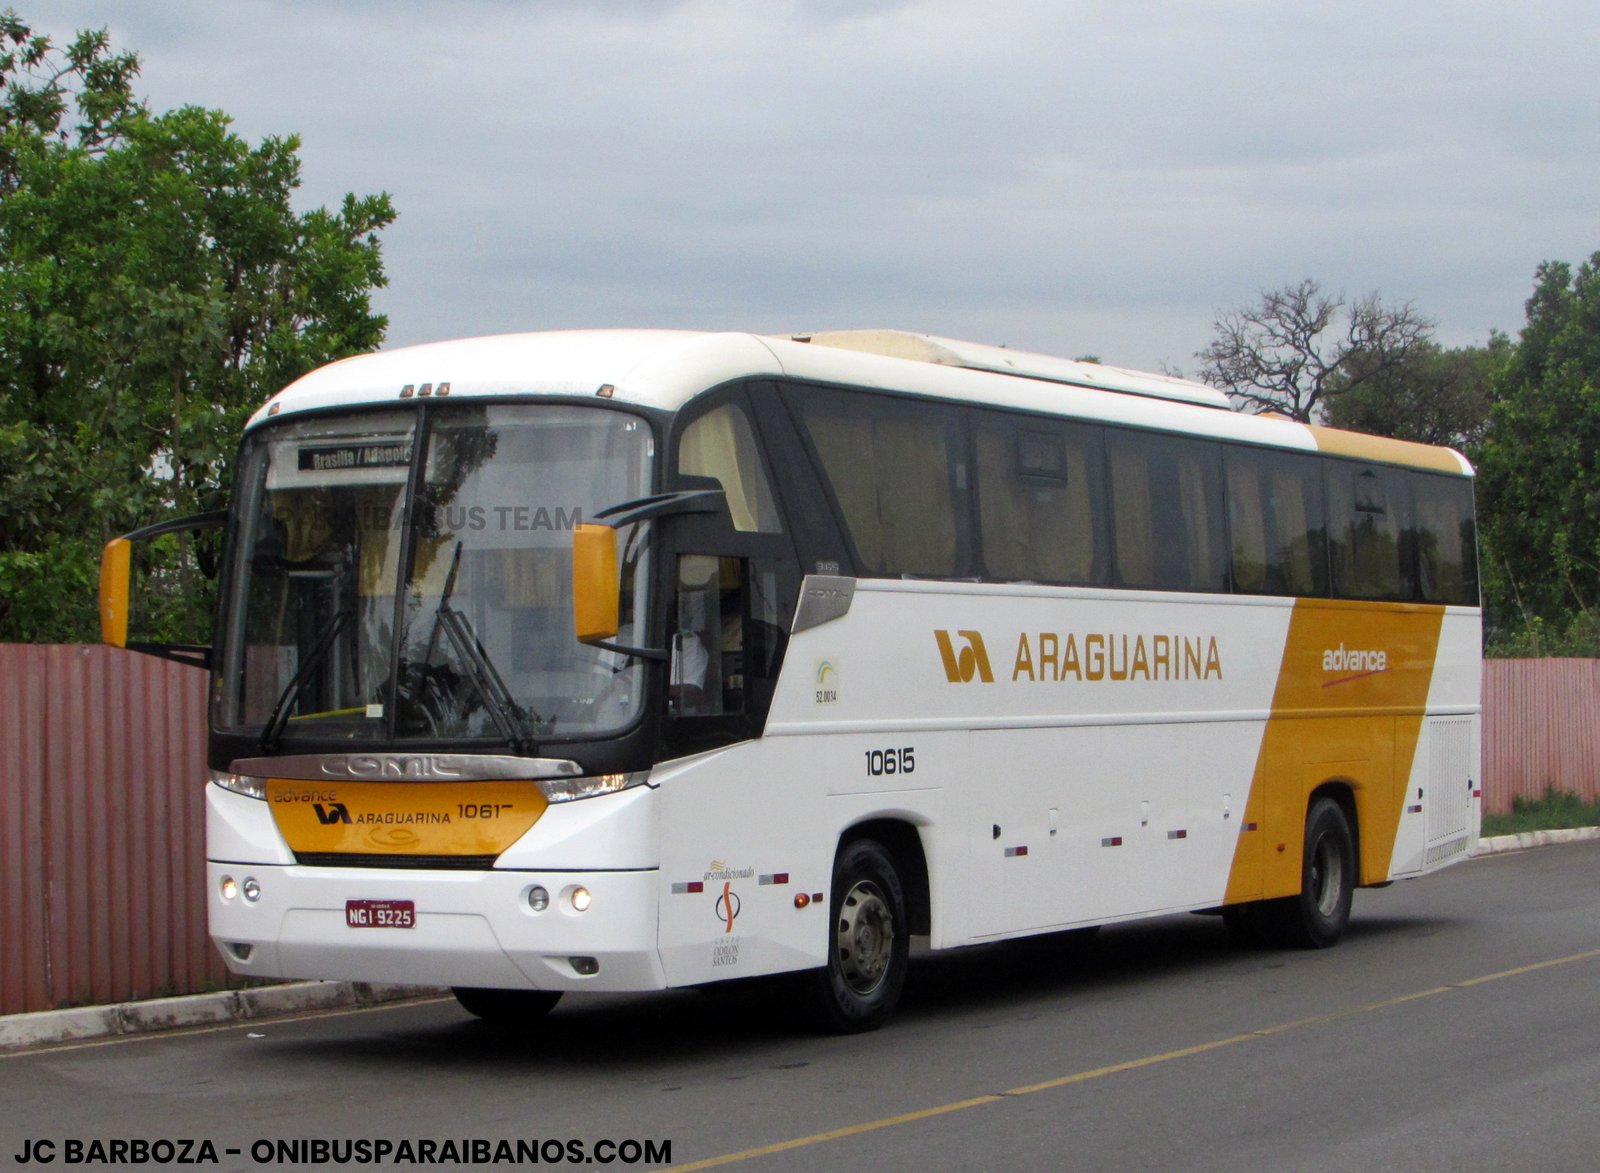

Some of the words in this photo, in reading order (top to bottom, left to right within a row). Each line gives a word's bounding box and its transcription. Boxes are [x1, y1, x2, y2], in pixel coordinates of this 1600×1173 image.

[1012, 632, 1223, 681] ARAGUARINA
[1322, 642, 1386, 671] advance
[320, 757, 461, 776] COMIL
[865, 747, 915, 776] 10615
[273, 788, 337, 802] advance
[356, 813, 451, 825] ARAGUARINA
[457, 803, 514, 819] 1061
[377, 910, 411, 925] 9225
[712, 955, 738, 967] SANTOS
